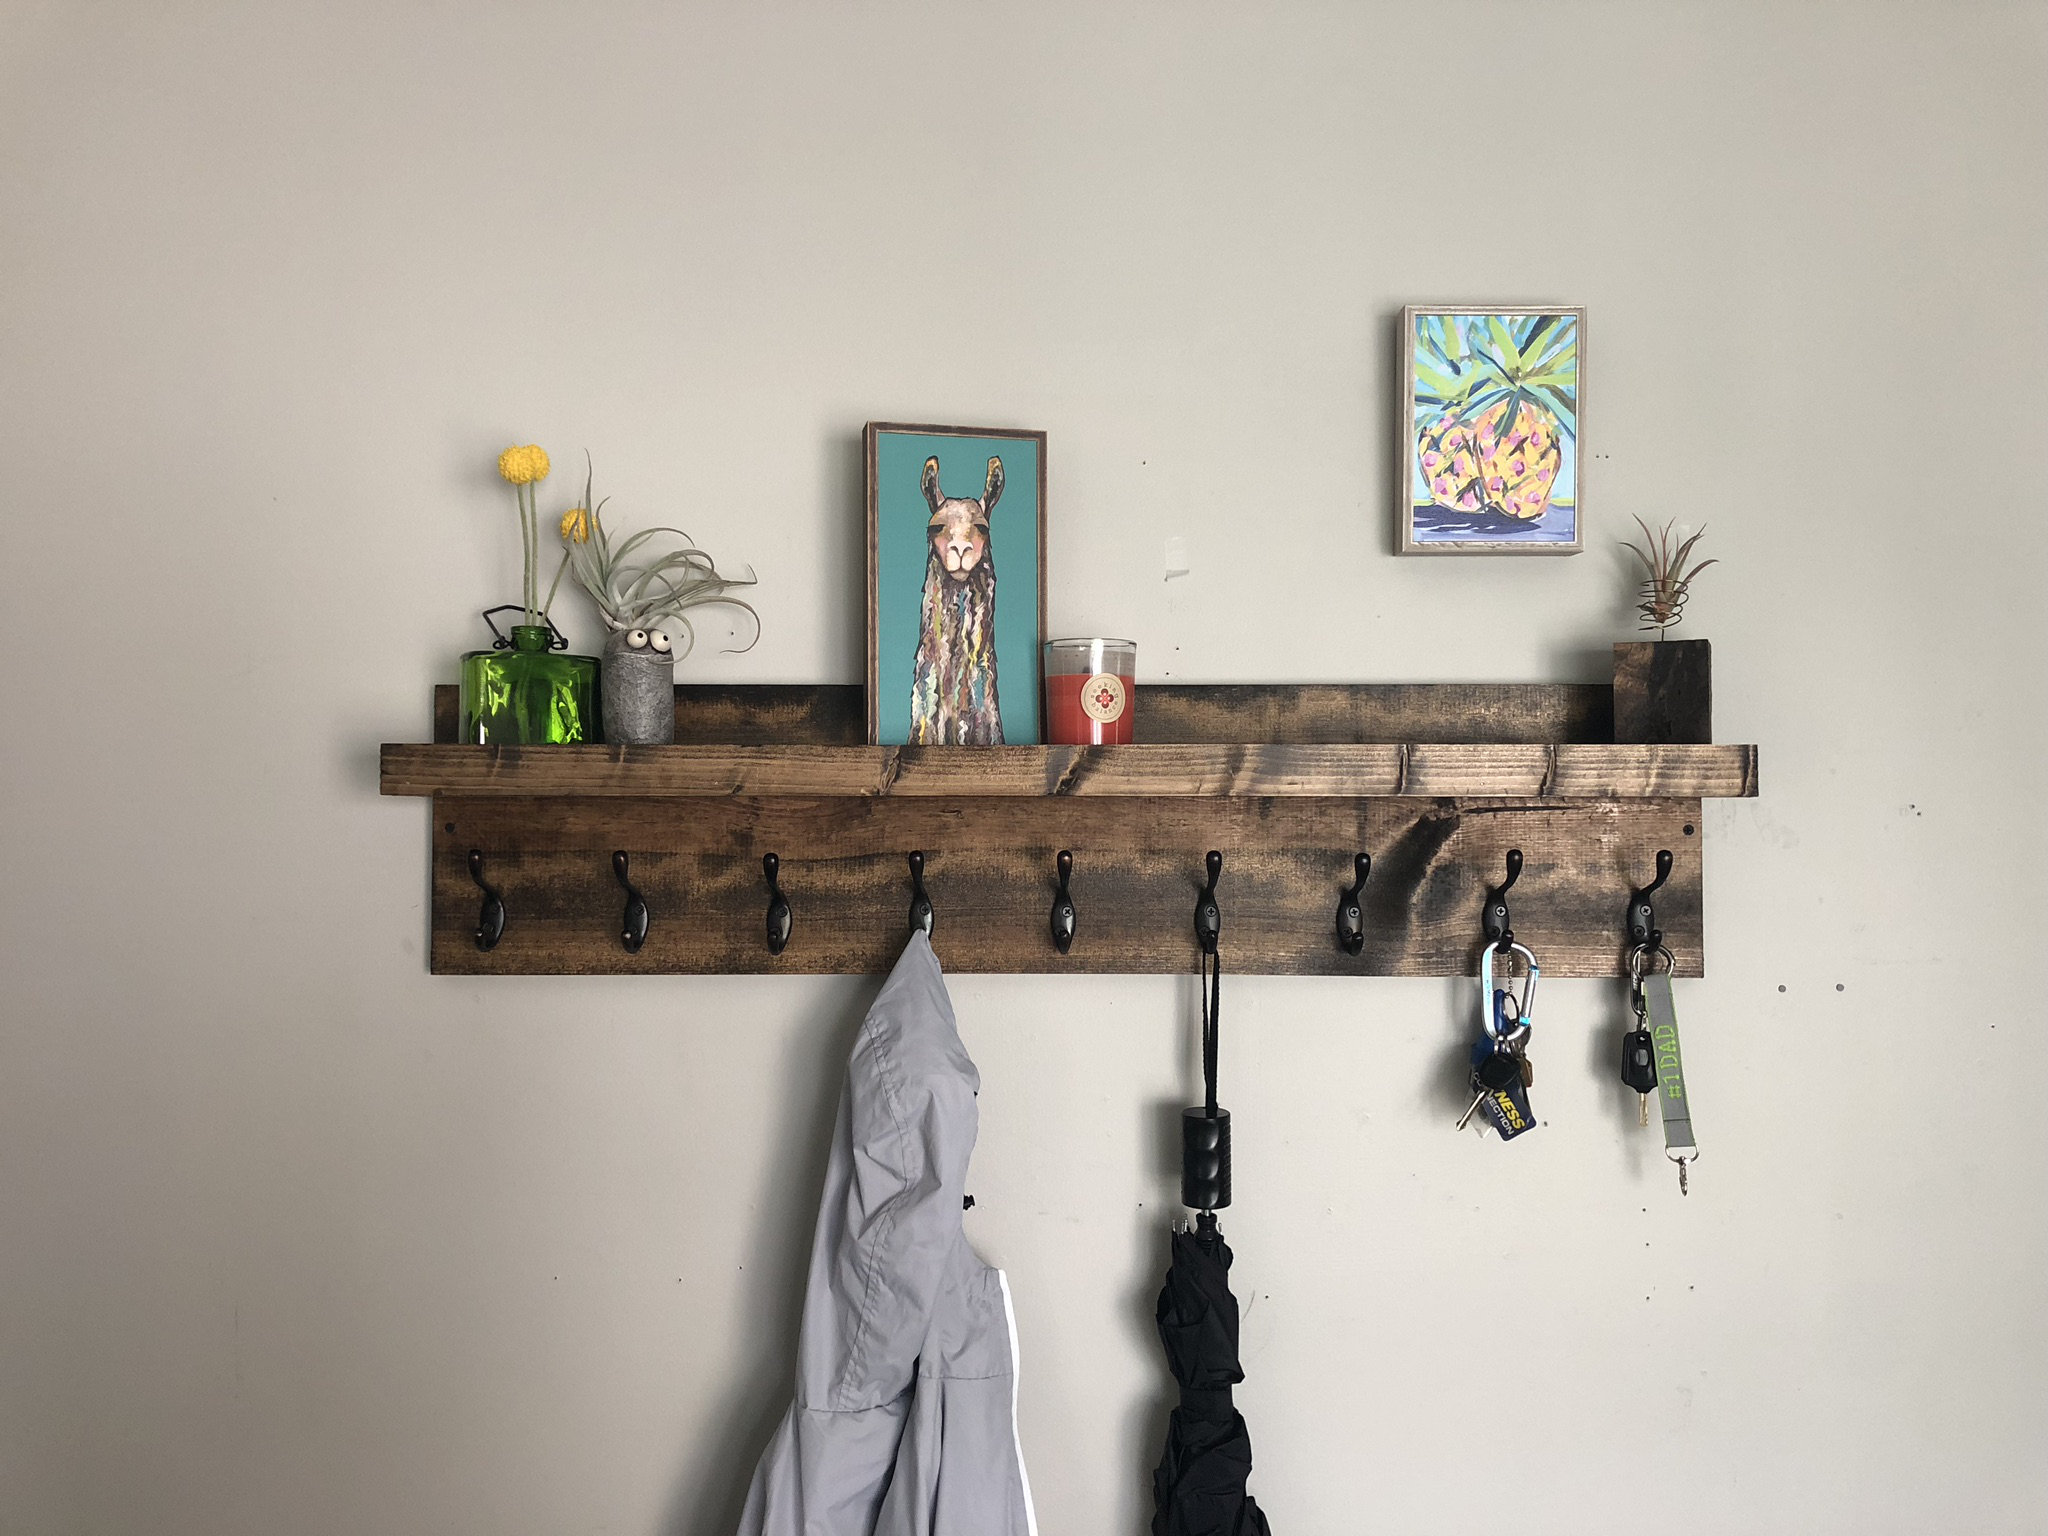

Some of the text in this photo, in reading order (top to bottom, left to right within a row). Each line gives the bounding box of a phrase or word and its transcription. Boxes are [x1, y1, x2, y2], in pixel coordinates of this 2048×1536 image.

[1655, 1025, 1681, 1099] #1 DAD
[1494, 1089, 1526, 1130] NESS
